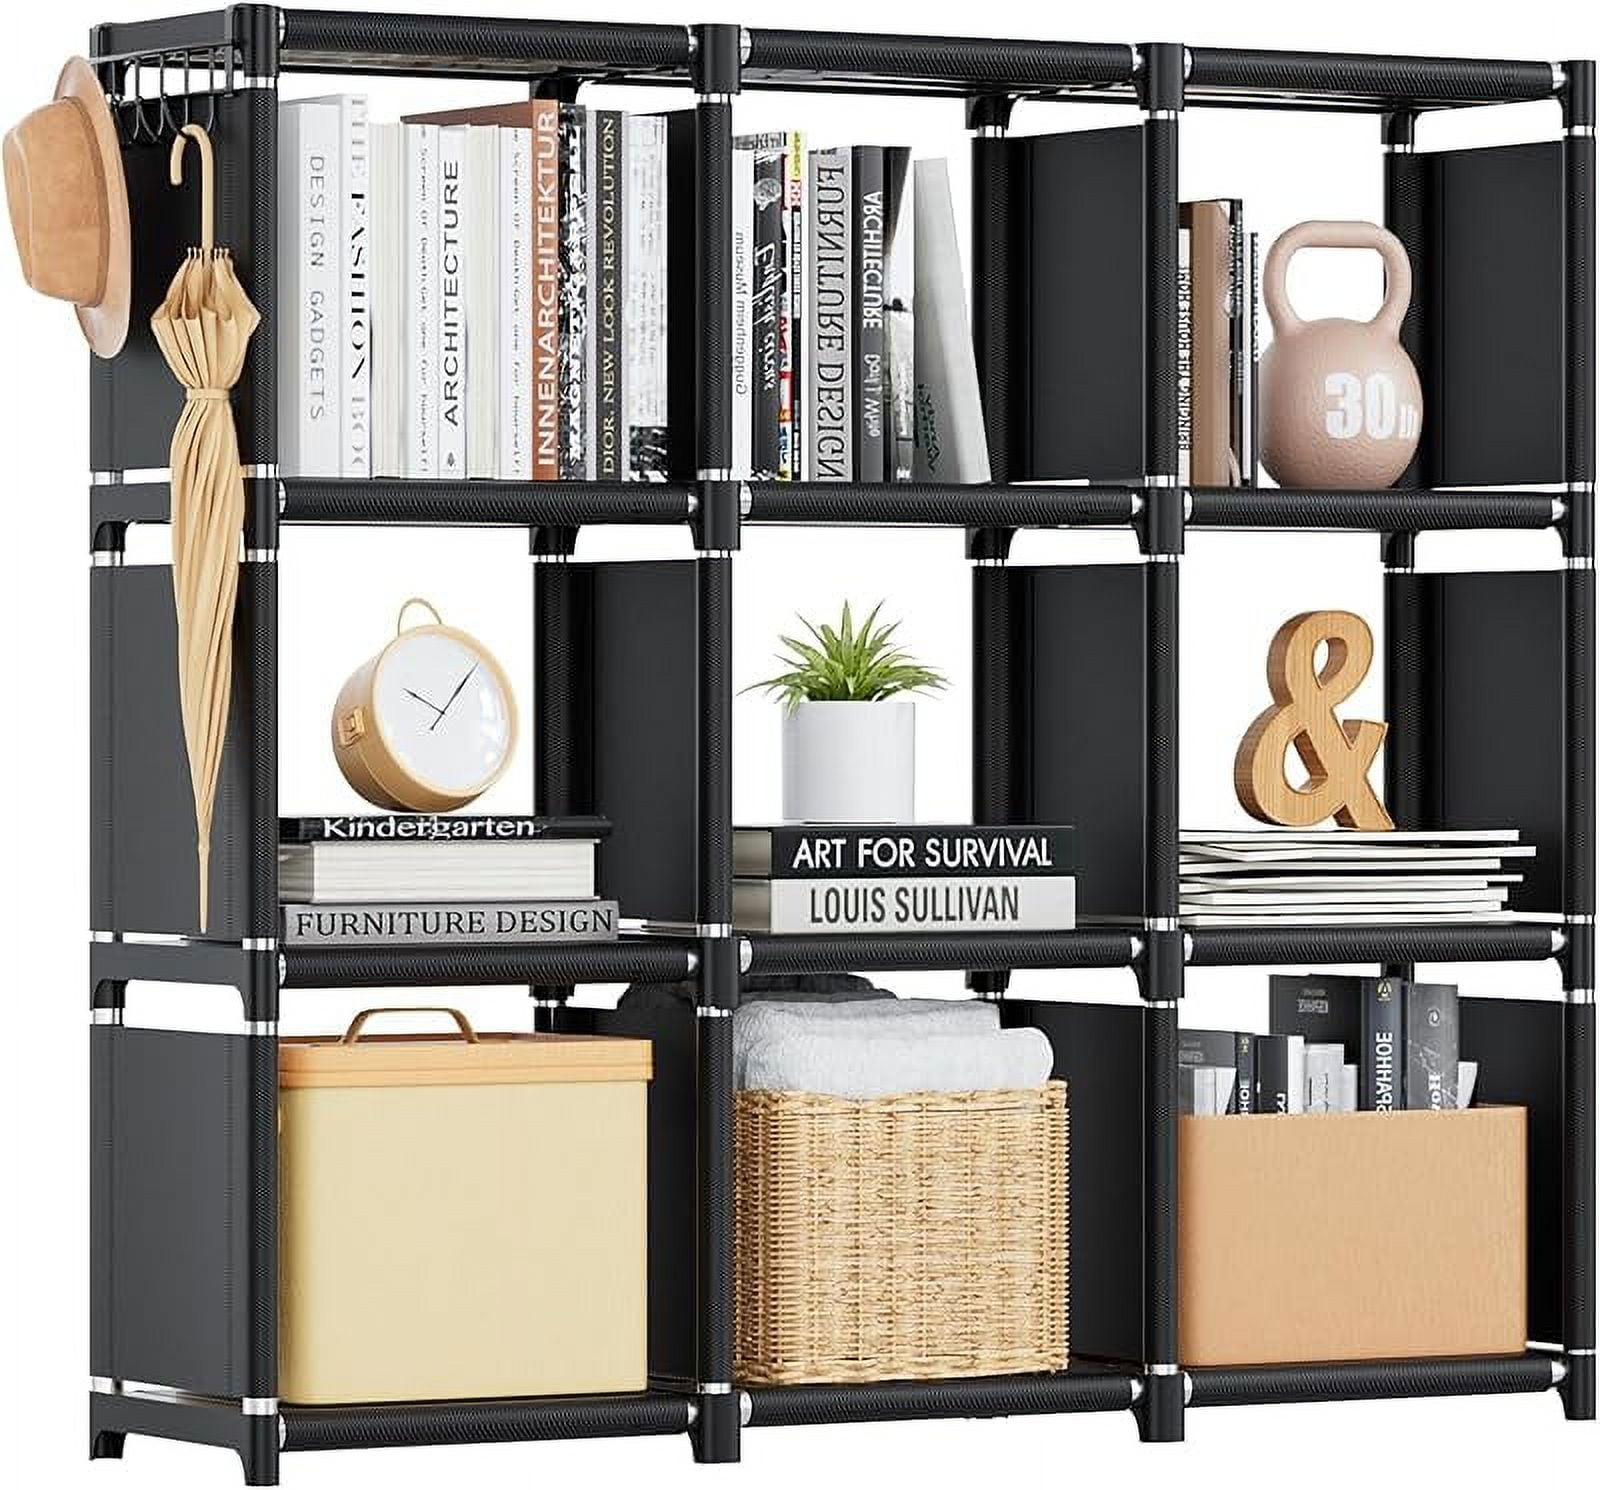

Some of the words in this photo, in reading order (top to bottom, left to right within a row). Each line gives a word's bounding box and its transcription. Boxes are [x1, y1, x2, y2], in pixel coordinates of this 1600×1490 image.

[308, 156, 325, 268] DESIGN
[603, 117, 616, 270] REVOLUTION
[351, 192, 367, 383] FASHION
[444, 160, 459, 427] ARCHITECTURE
[537, 111, 556, 467] INNENARCHITEKTUR
[603, 279, 616, 344] LOOK
[308, 291, 325, 420] GADGETS
[603, 351, 616, 403] NEW
[324, 816, 536, 840] Kindergarten
[792, 837, 847, 870] ART
[857, 837, 916, 868] FOR
[924, 836, 1053, 869] SURVIVAL
[296, 909, 486, 937] FURNITURE
[495, 908, 614, 935] DESIGN
[810, 886, 886, 925] LOUIS
[894, 884, 1019, 923] SULLIVAN
